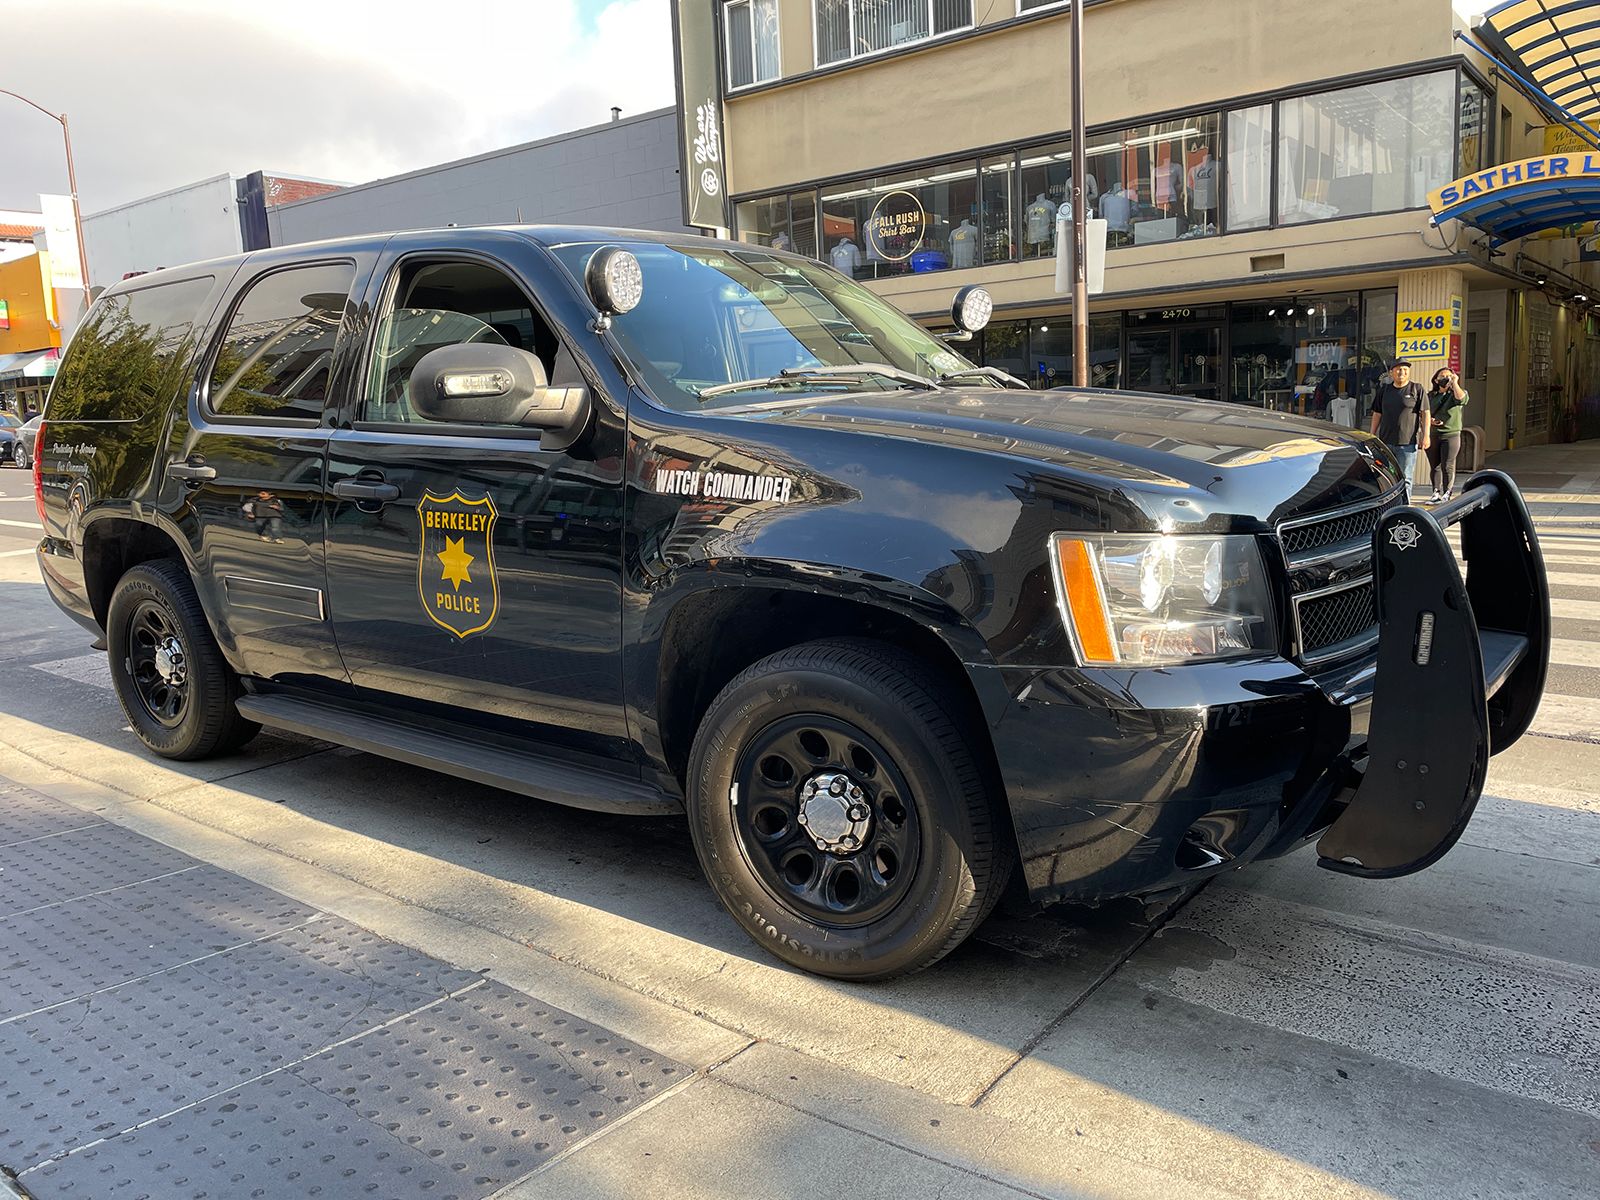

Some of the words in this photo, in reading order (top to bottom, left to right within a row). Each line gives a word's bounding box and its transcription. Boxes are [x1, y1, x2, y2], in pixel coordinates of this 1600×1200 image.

[1440, 157, 1569, 206] SATHER
[874, 215, 895, 228] FALL
[896, 210, 919, 225] RUSH
[878, 227, 898, 238] Shirt
[899, 224, 917, 236] Bar
[1162, 308, 1191, 319] 2470
[1402, 315, 1445, 332] 2468
[1308, 342, 1339, 357] COPY
[1400, 339, 1439, 353] 2466
[656, 469, 700, 495] WATCH
[703, 471, 792, 503] COMMANDER
[426, 510, 488, 532] BERKELEY
[436, 592, 481, 615] POLICE
